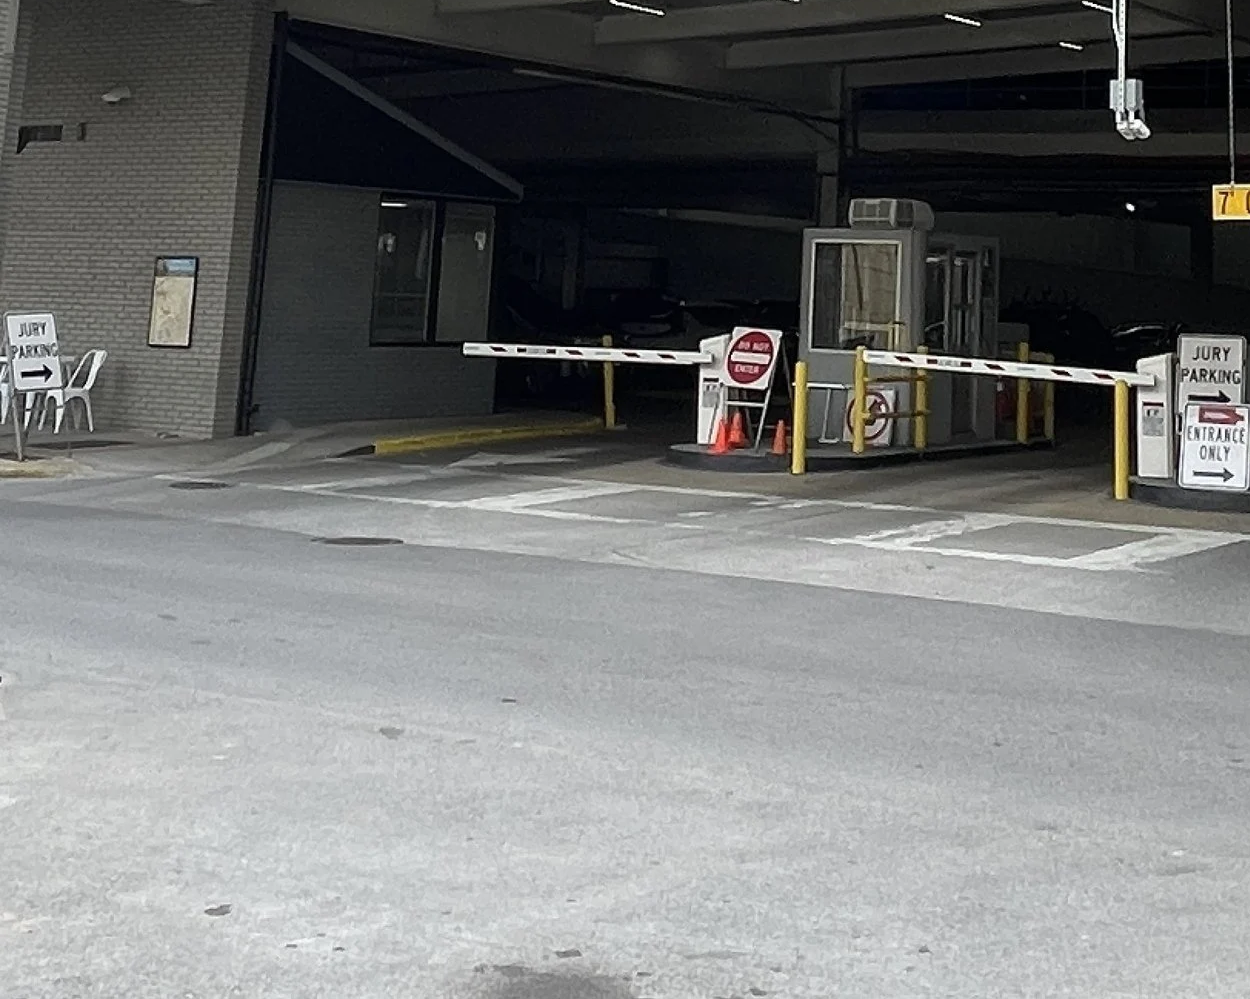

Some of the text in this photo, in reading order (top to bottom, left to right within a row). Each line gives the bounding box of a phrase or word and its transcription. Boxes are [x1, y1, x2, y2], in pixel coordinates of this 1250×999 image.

[18, 322, 47, 337] JURY
[10, 343, 59, 359] PARKING
[1192, 346, 1231, 362] JURY
[1181, 368, 1241, 385] PARKING
[1187, 425, 1246, 445] ENTRANCE
[1199, 445, 1231, 462] ONLY
